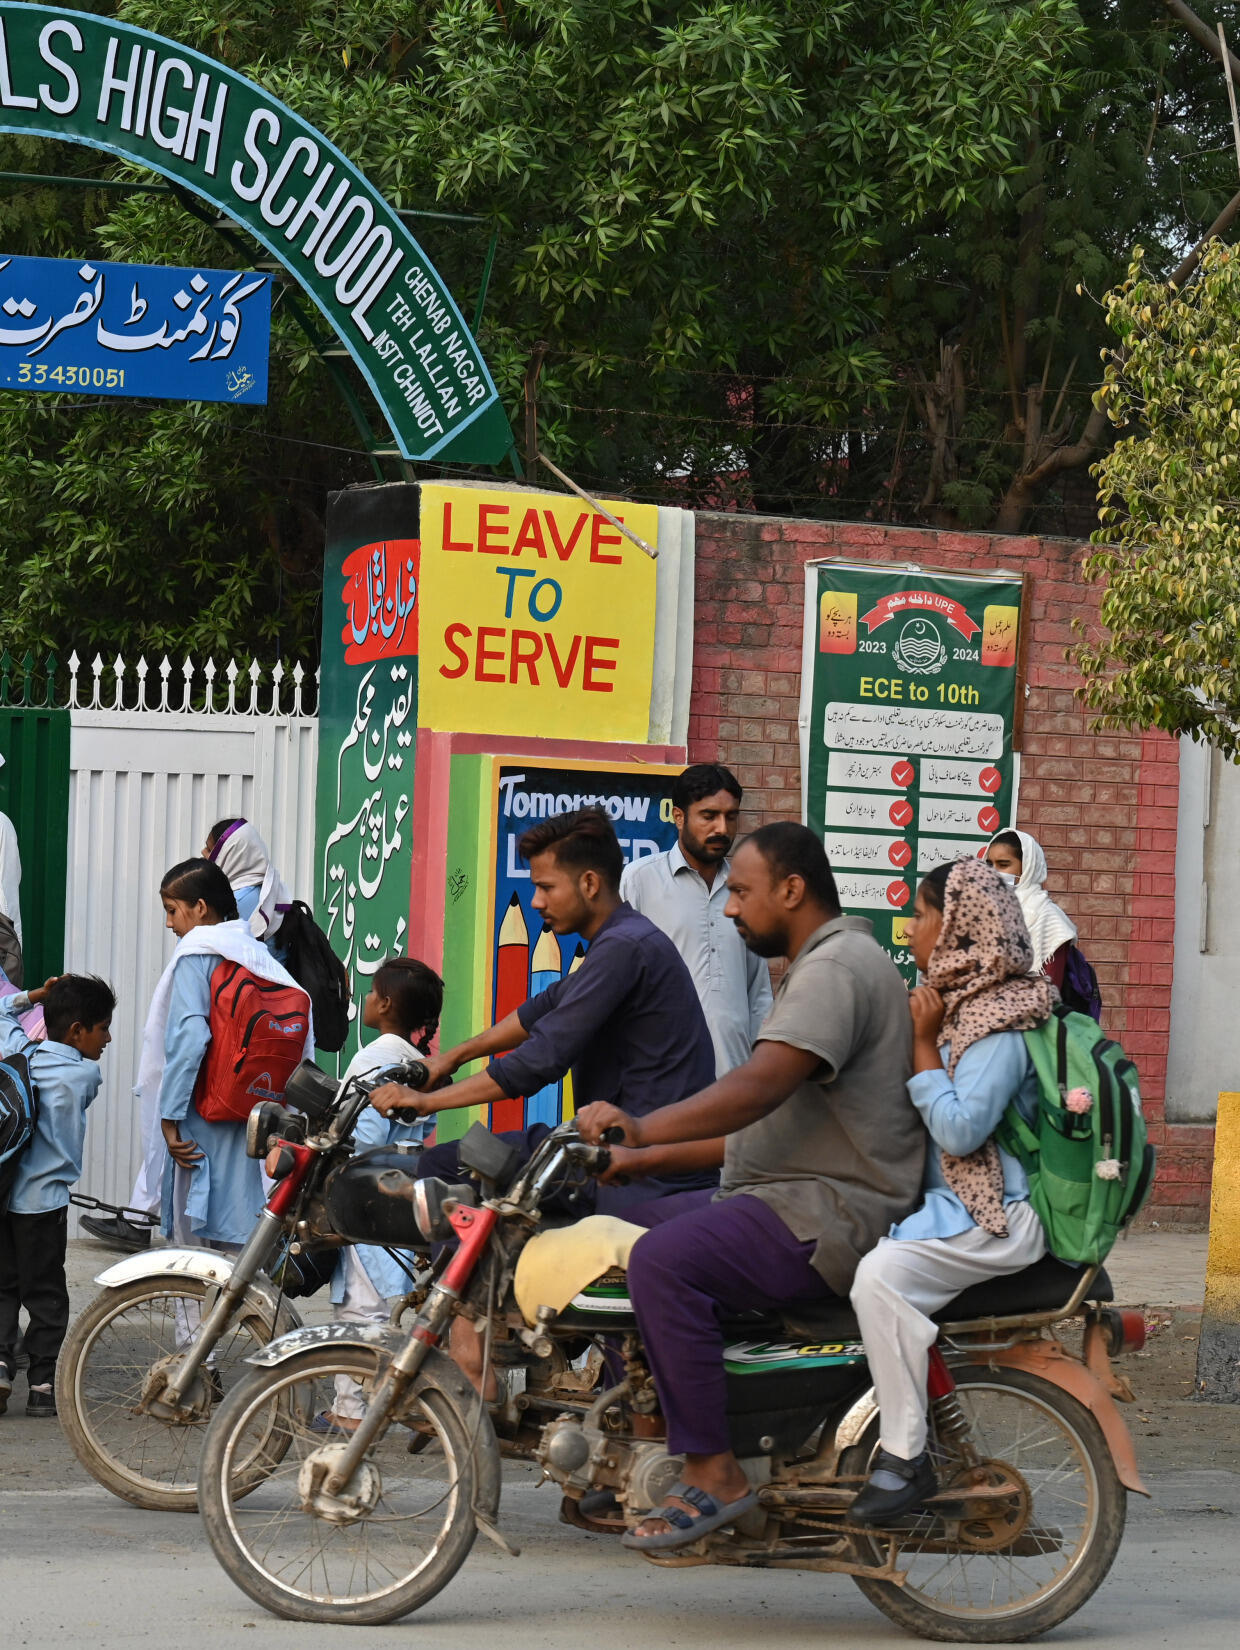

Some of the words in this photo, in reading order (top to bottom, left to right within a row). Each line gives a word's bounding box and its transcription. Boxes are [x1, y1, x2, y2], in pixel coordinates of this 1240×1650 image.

[97, 37, 228, 176] HIGH
[231, 108, 404, 342] SCHOOL
[97, 273, 268, 361] گورنمنٹ
[404, 266, 451, 335] CHENAB
[441, 331, 486, 406] NAGAR
[18, 363, 125, 388] 33430051
[386, 292, 417, 332] TEH
[409, 329, 462, 419] LALLIAN
[393, 364, 444, 438] CHINIOT
[441, 502, 625, 565] LEAVE
[495, 566, 563, 622] TO
[935, 597, 955, 614] UPE
[438, 623, 620, 693] SERVE
[859, 640, 887, 654] 2023
[953, 647, 979, 661] 2024
[860, 676, 903, 699] ECE
[909, 682, 929, 701] to
[936, 683, 979, 705] 10th
[358, 793, 409, 900] عمل
